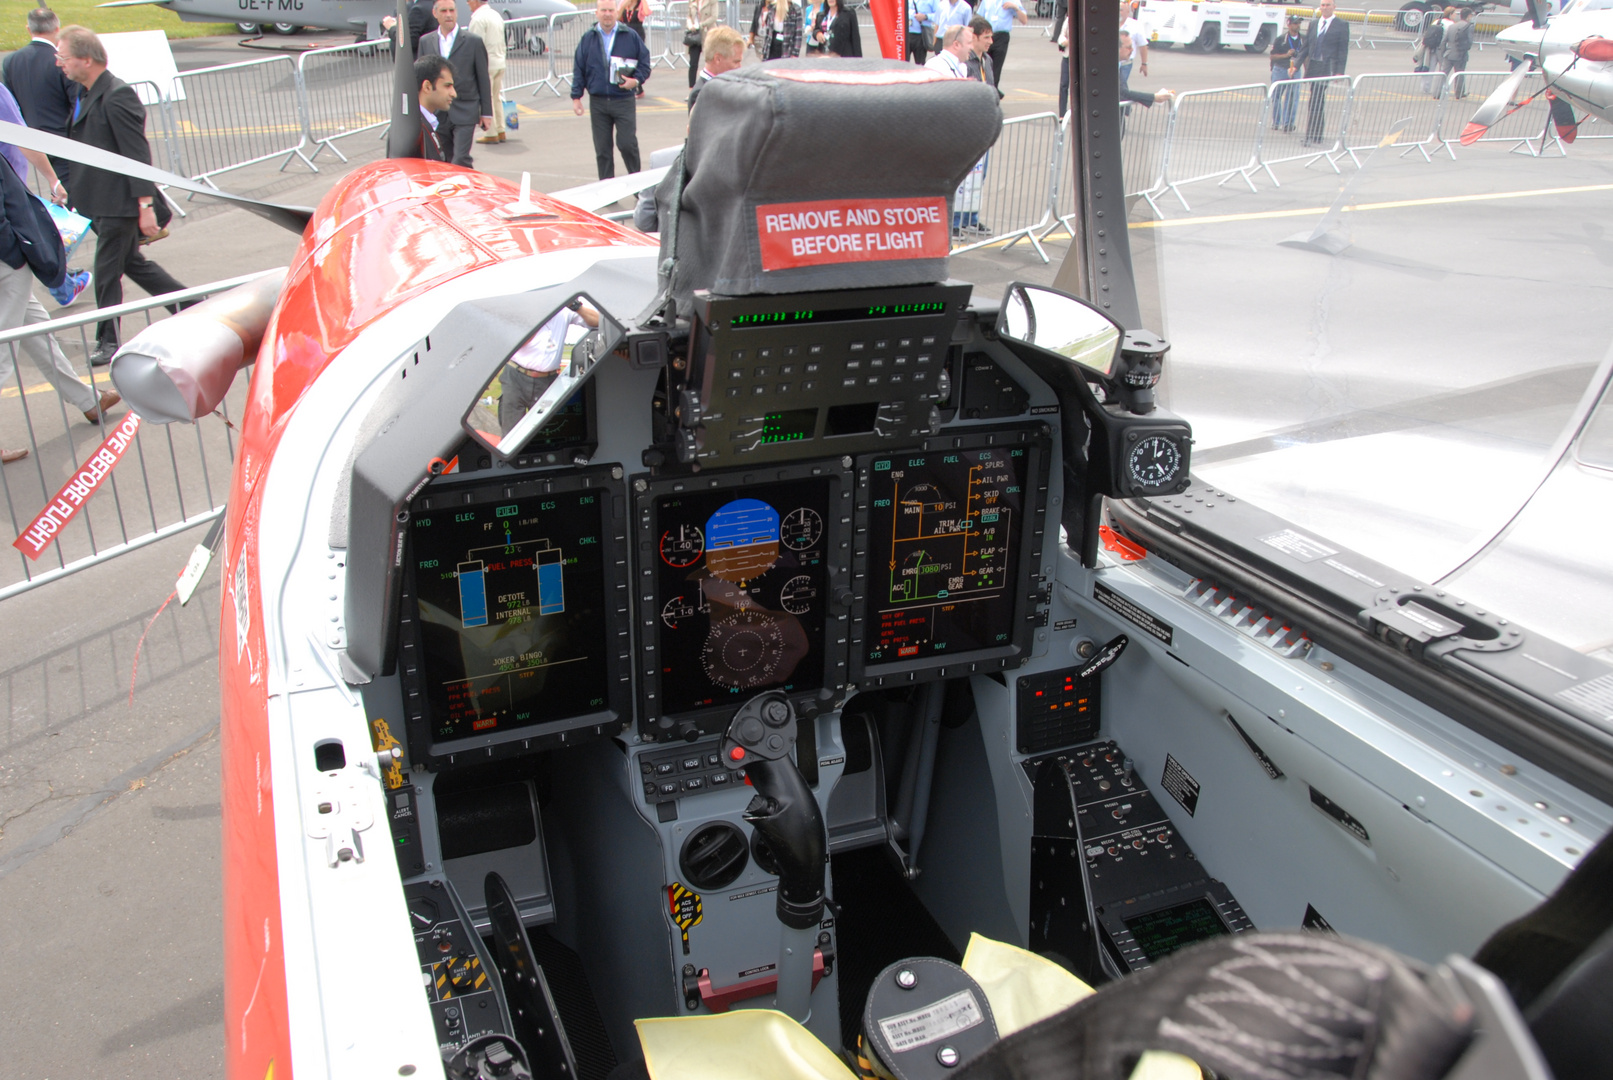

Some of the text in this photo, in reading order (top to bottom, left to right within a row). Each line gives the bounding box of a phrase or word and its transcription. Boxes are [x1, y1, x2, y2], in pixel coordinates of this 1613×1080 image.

[765, 206, 940, 233] REMOVE AND STORE
[791, 231, 924, 256] BEFORE FLIGHT
[574, 457, 588, 465] BARO
[909, 459, 925, 467] ELEC
[944, 456, 959, 464] FUEL
[876, 462, 890, 470] HYD
[985, 461, 1004, 470] SPLRS
[62, 448, 117, 506] BEFORE
[891, 471, 904, 479] ENG
[982, 476, 993, 484] AIL
[1006, 486, 1021, 494] CHKL
[580, 496, 594, 505] ENG
[874, 499, 891, 507] FREQ
[986, 497, 997, 505] OFF
[541, 502, 556, 511] ECS
[904, 506, 920, 515] MAIN
[497, 506, 517, 517] FUEL
[981, 507, 1000, 515] BRAKE
[455, 513, 475, 523] ELEC
[24, 498, 74, 552] FLIGHT
[416, 519, 432, 528] HYD
[484, 523, 494, 531] FF
[934, 526, 946, 534] AIL
[983, 528, 995, 536] A/B
[579, 537, 597, 545] CHKL
[505, 546, 515, 555] 23
[981, 547, 996, 555] FLAP
[419, 560, 439, 569] FREQ
[488, 558, 533, 571] FUEL PRESS
[902, 568, 918, 576] EMRG
[941, 563, 952, 571] PSI
[441, 572, 453, 580] 510
[948, 576, 964, 585] EMRG
[498, 592, 526, 603] DETOTE
[496, 607, 531, 620] INTERNAL
[909, 617, 926, 625] PRESS
[996, 633, 1007, 641] OPS
[934, 642, 947, 650] NAV
[493, 651, 543, 667] JOKER BINGO
[519, 671, 535, 679] STEP
[590, 698, 604, 706] OPS
[517, 712, 530, 721] NAV
[476, 720, 494, 729] WARN
[440, 727, 454, 736] SYS
[394, 811, 412, 819] CANCEL
